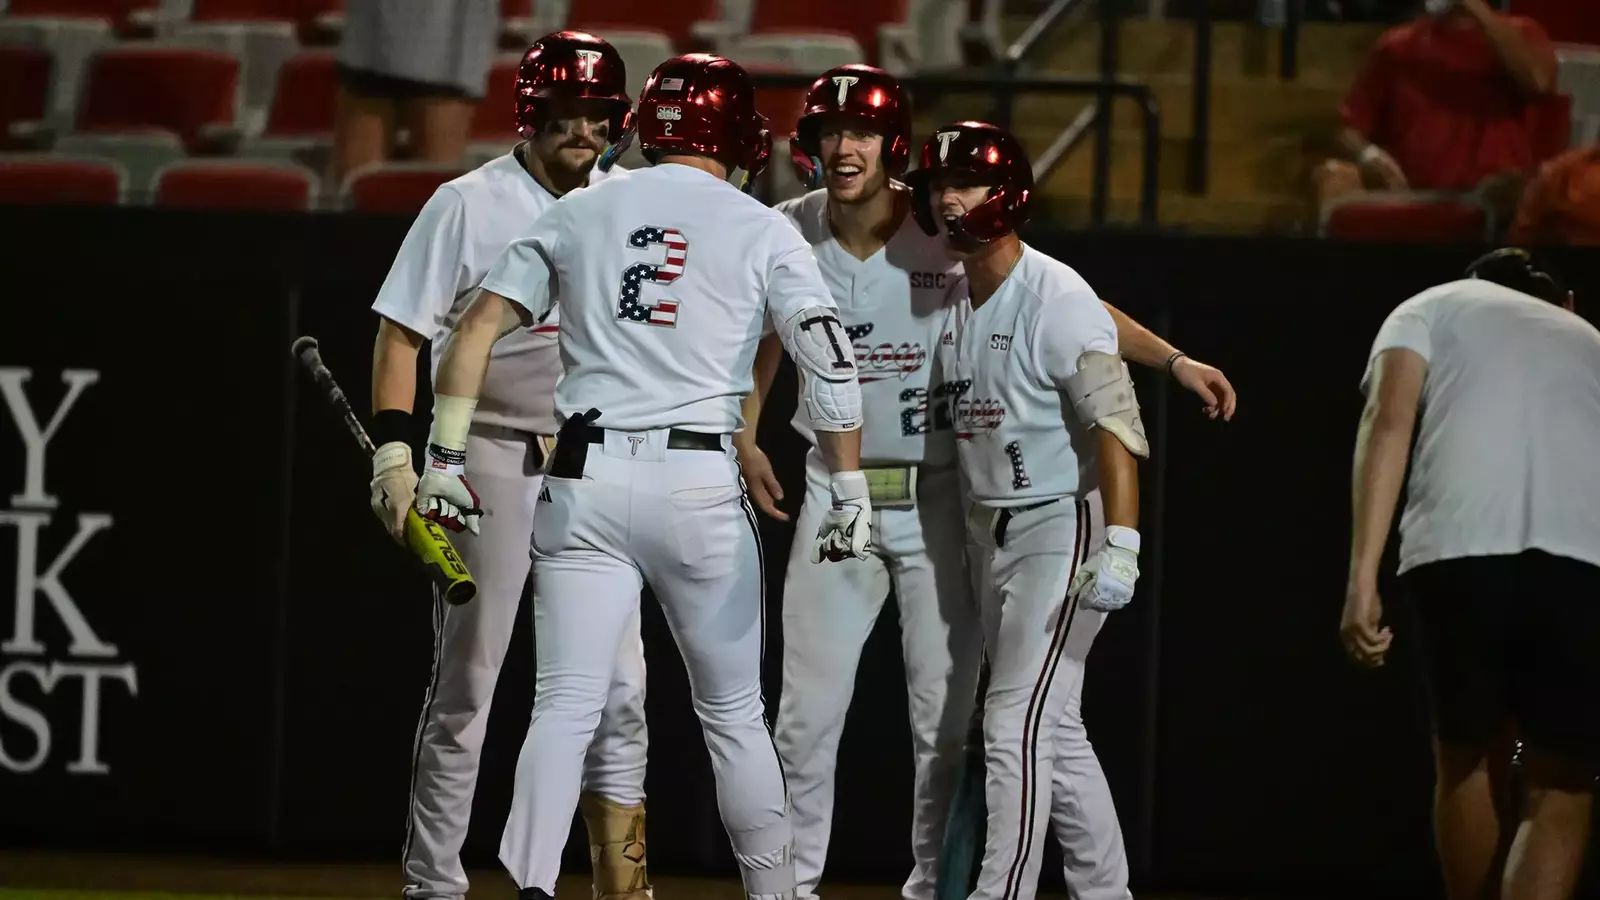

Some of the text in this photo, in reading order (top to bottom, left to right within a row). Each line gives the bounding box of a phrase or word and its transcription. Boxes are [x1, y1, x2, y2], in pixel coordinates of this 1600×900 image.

[656, 106, 682, 121] SBC
[664, 122, 673, 136] 2
[614, 224, 689, 329] 2
[911, 272, 946, 289] SBC
[1004, 440, 1031, 491] 1
[423, 518, 469, 574] LINGS
